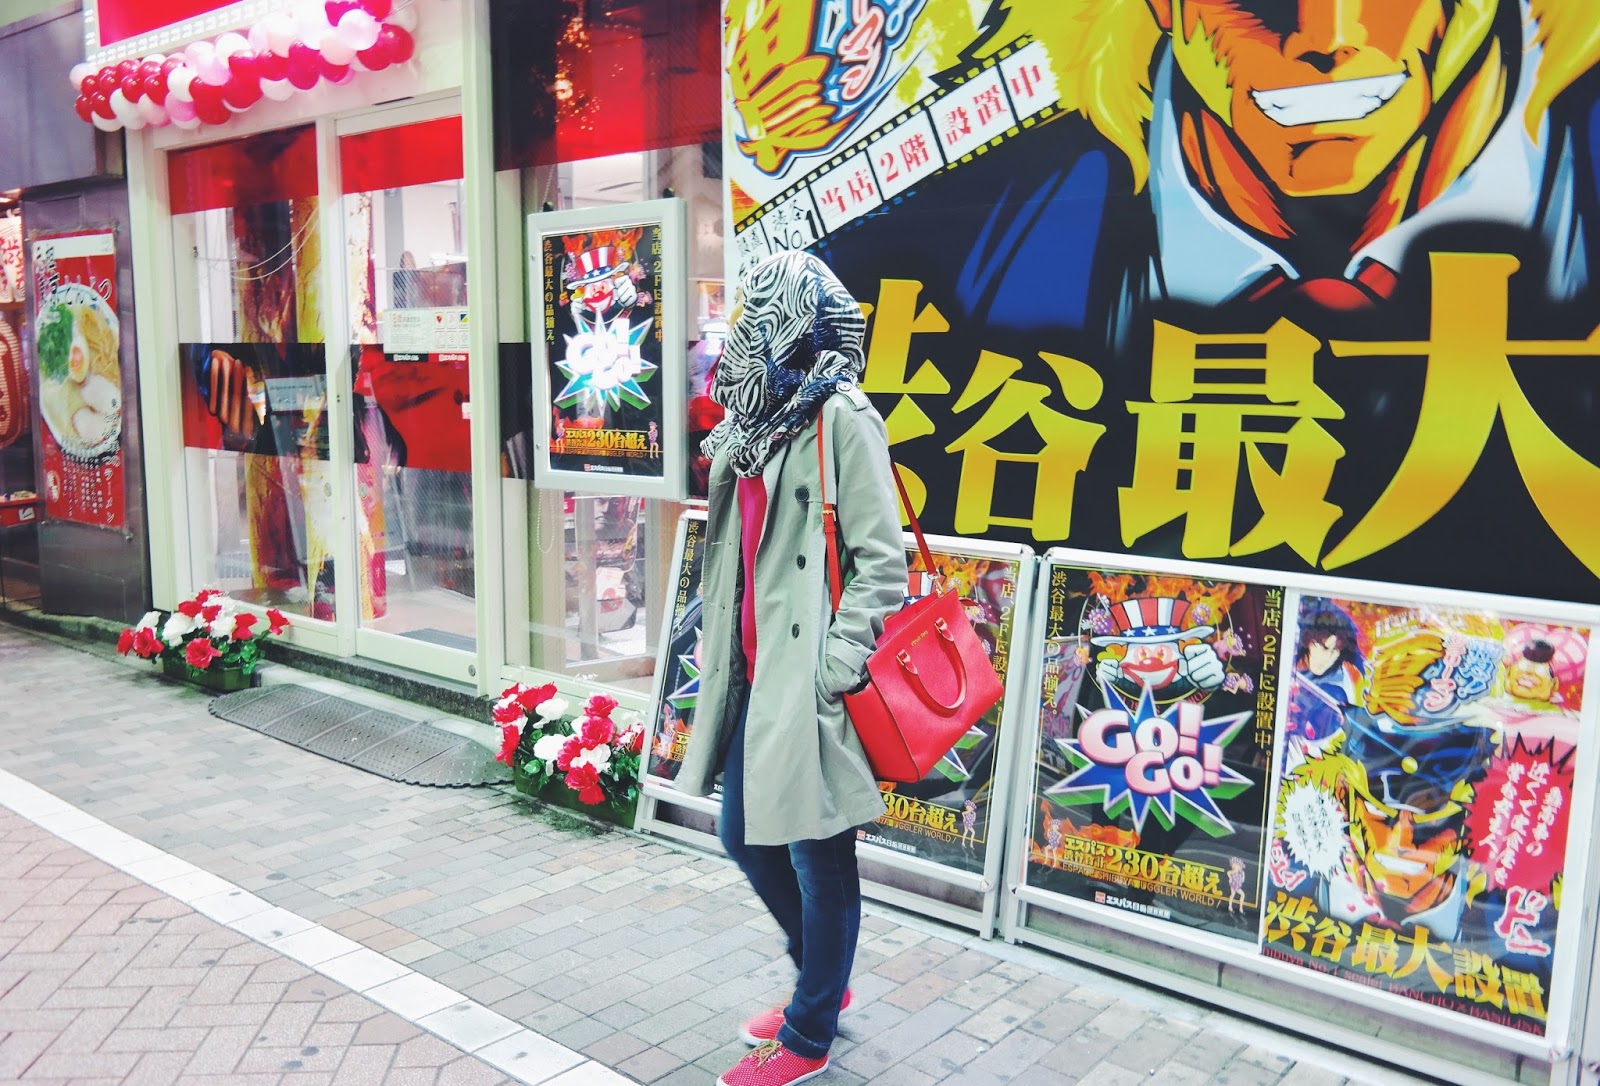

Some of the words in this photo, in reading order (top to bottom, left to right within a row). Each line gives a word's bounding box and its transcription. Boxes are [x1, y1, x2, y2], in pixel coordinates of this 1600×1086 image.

[820, 65, 1041, 217] 当店2階設置中
[674, 521, 699, 636] 渋谷最大の品揃え。
[1043, 570, 1066, 715] 渋谷最大の品揃え。
[1065, 836, 1105, 857] エスパス
[1106, 846, 1222, 896] 230台超え
